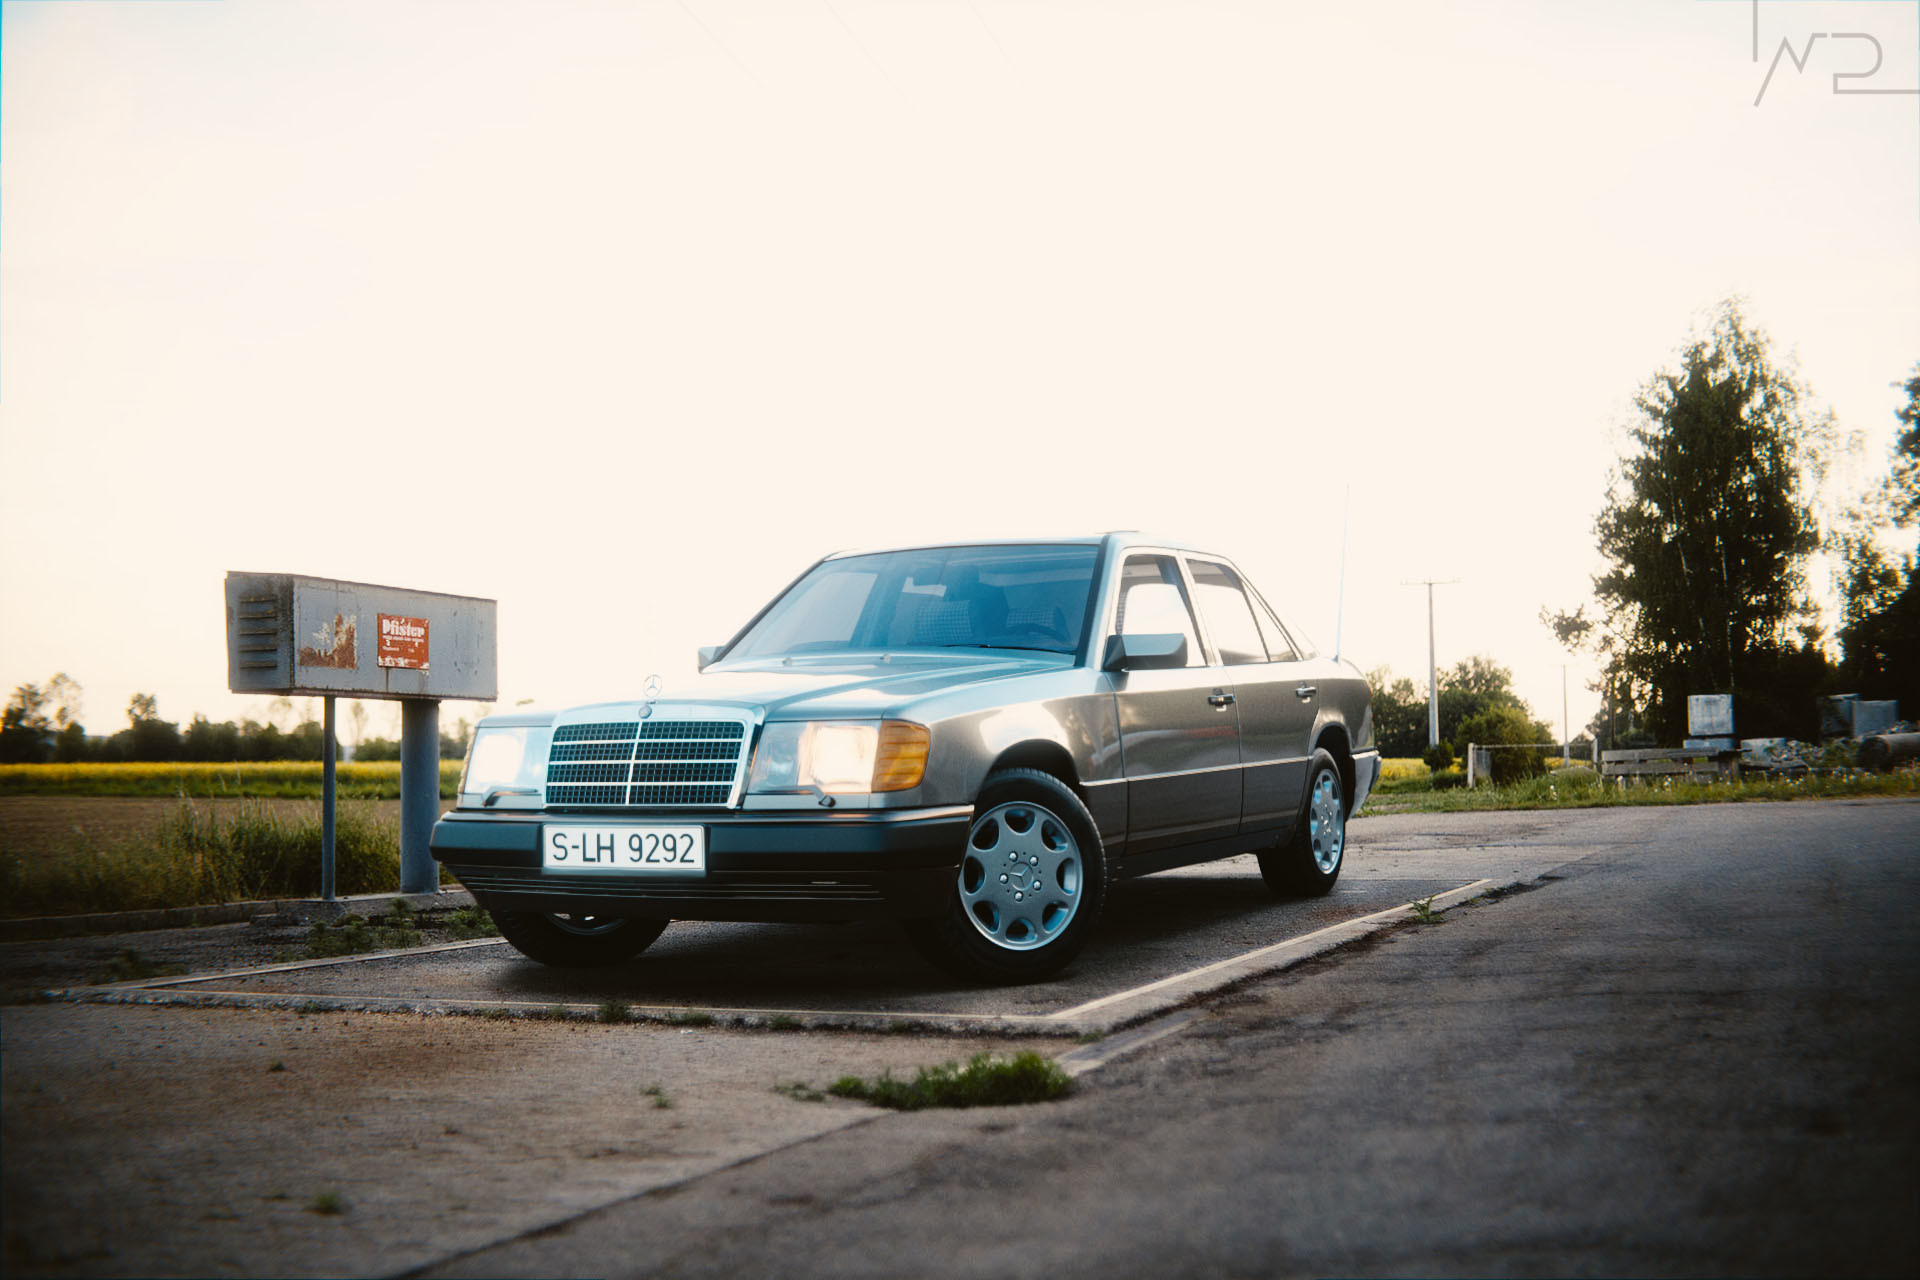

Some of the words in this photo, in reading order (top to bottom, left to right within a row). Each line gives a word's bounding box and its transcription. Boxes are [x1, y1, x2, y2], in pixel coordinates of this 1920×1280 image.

[382, 618, 425, 637] Pfister
[552, 832, 615, 863] S-LH
[628, 833, 695, 863] 9292
